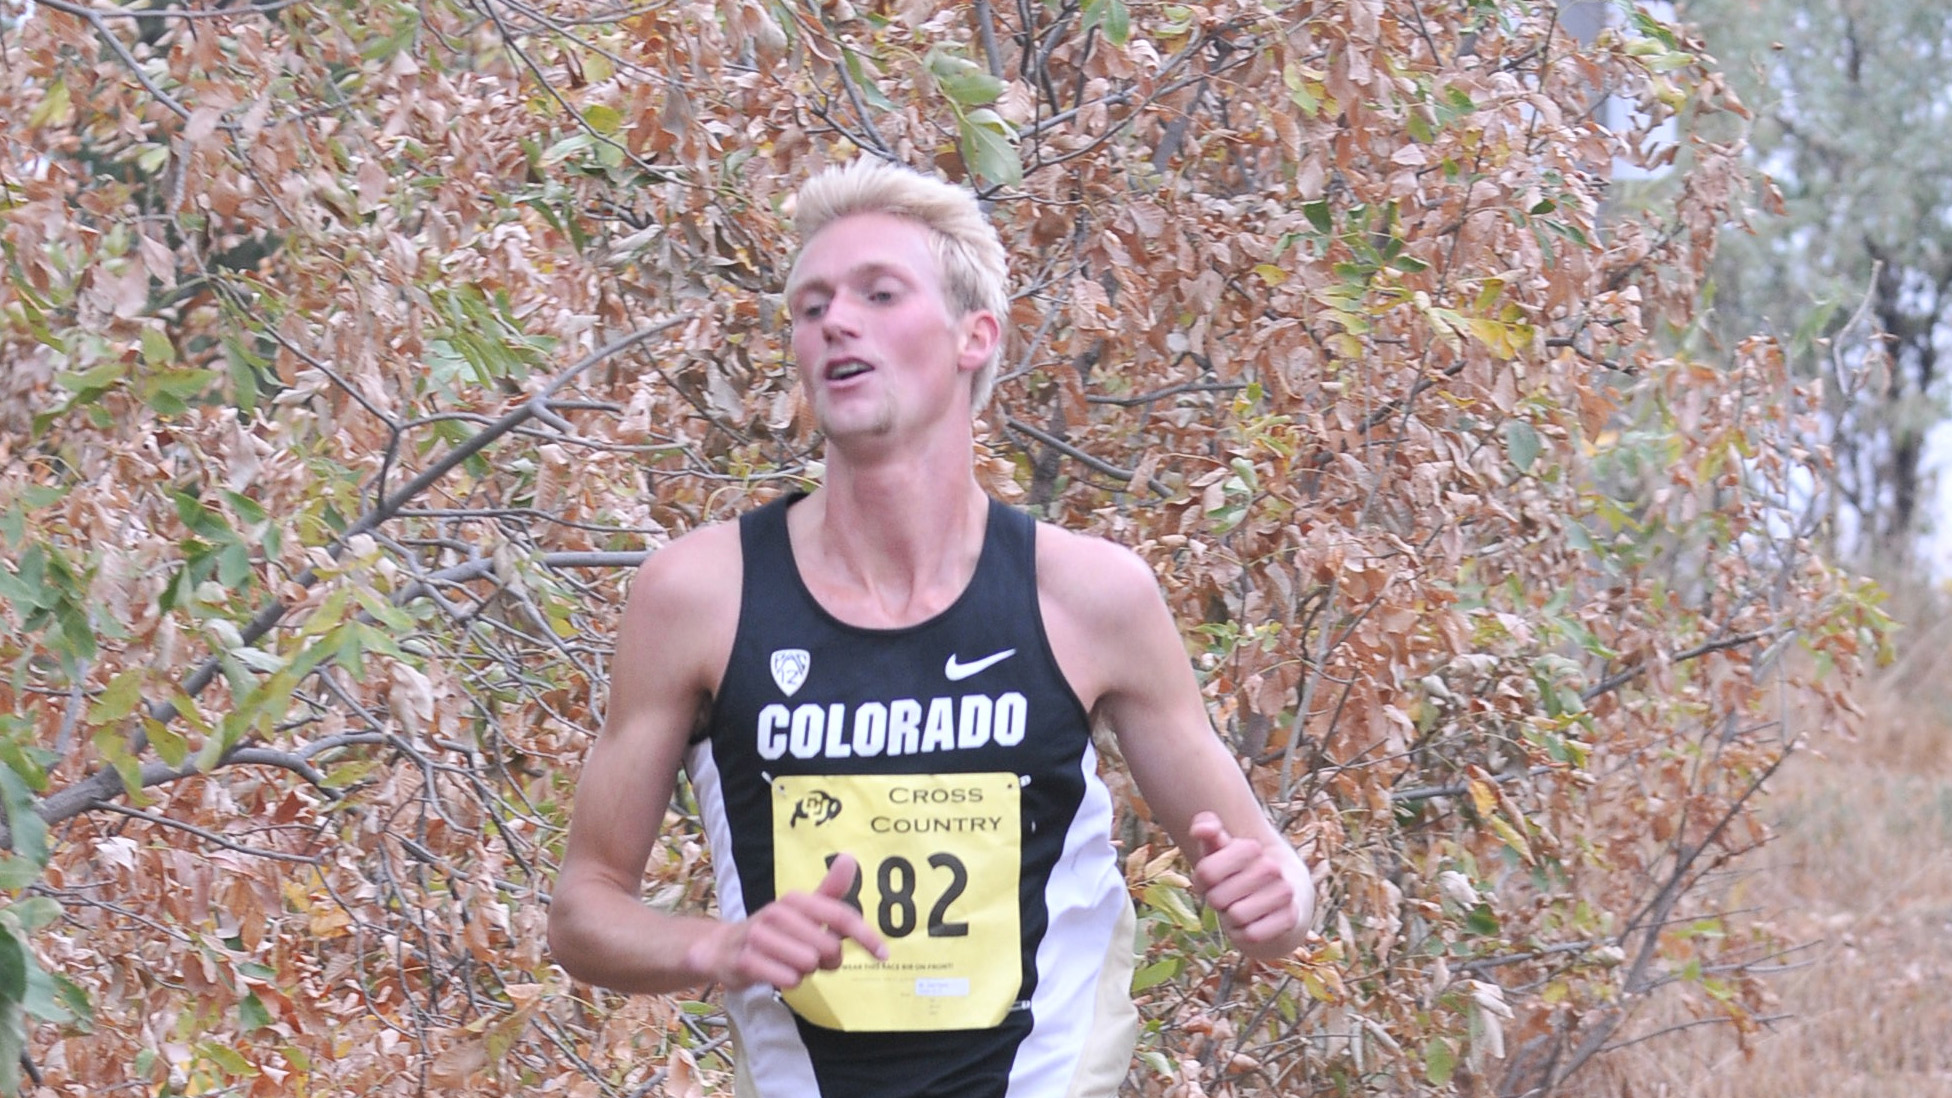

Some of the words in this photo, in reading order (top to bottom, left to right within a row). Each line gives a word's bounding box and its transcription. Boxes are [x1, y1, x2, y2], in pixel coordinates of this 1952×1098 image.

[780, 669, 798, 685] 12
[757, 692, 1028, 760] COLORADO
[889, 787, 983, 804] CROSS
[871, 816, 1002, 833] COUNTRY
